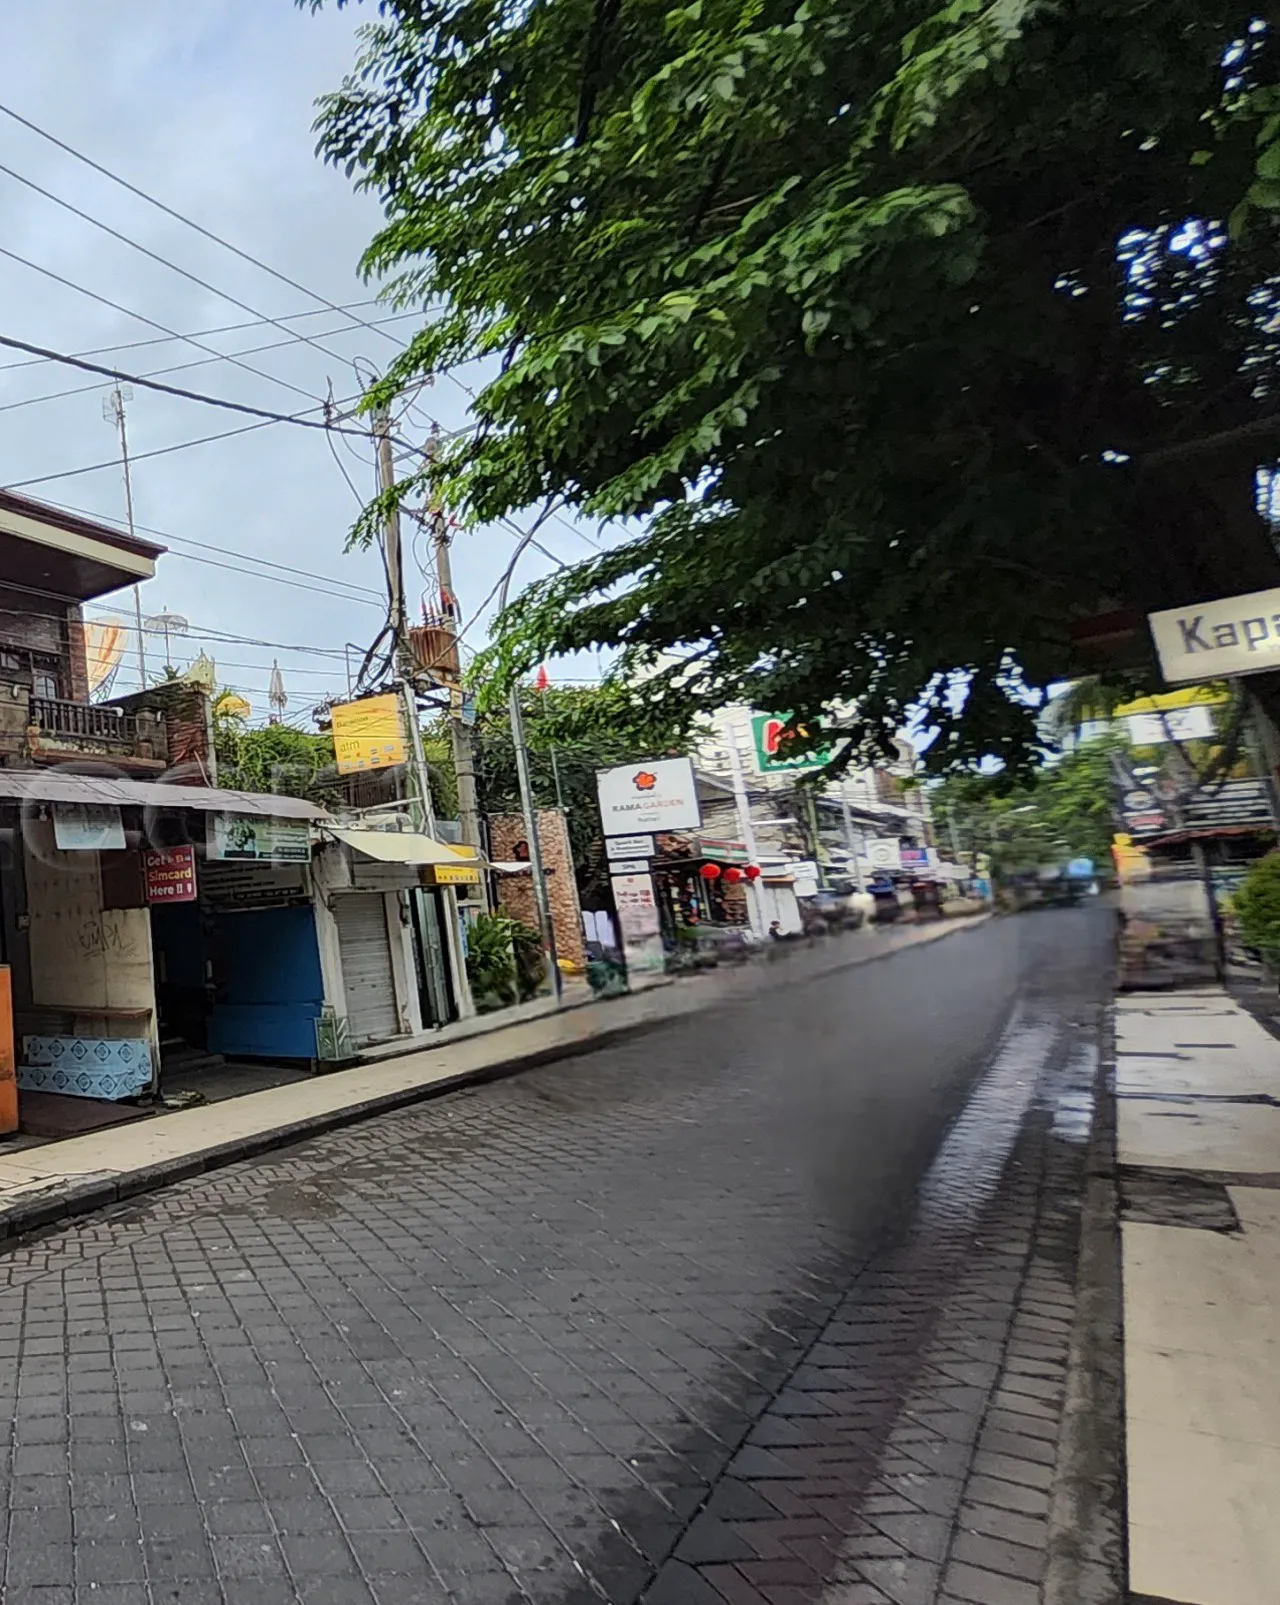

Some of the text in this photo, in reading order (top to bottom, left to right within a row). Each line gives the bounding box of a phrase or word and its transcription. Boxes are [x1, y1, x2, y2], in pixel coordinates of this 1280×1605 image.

[340, 740, 360, 752] atm
[612, 799, 684, 812] RAMA GARDEN
[147, 855, 165, 867] Get
[148, 867, 192, 882] Simcard
[150, 886, 174, 897] Here
